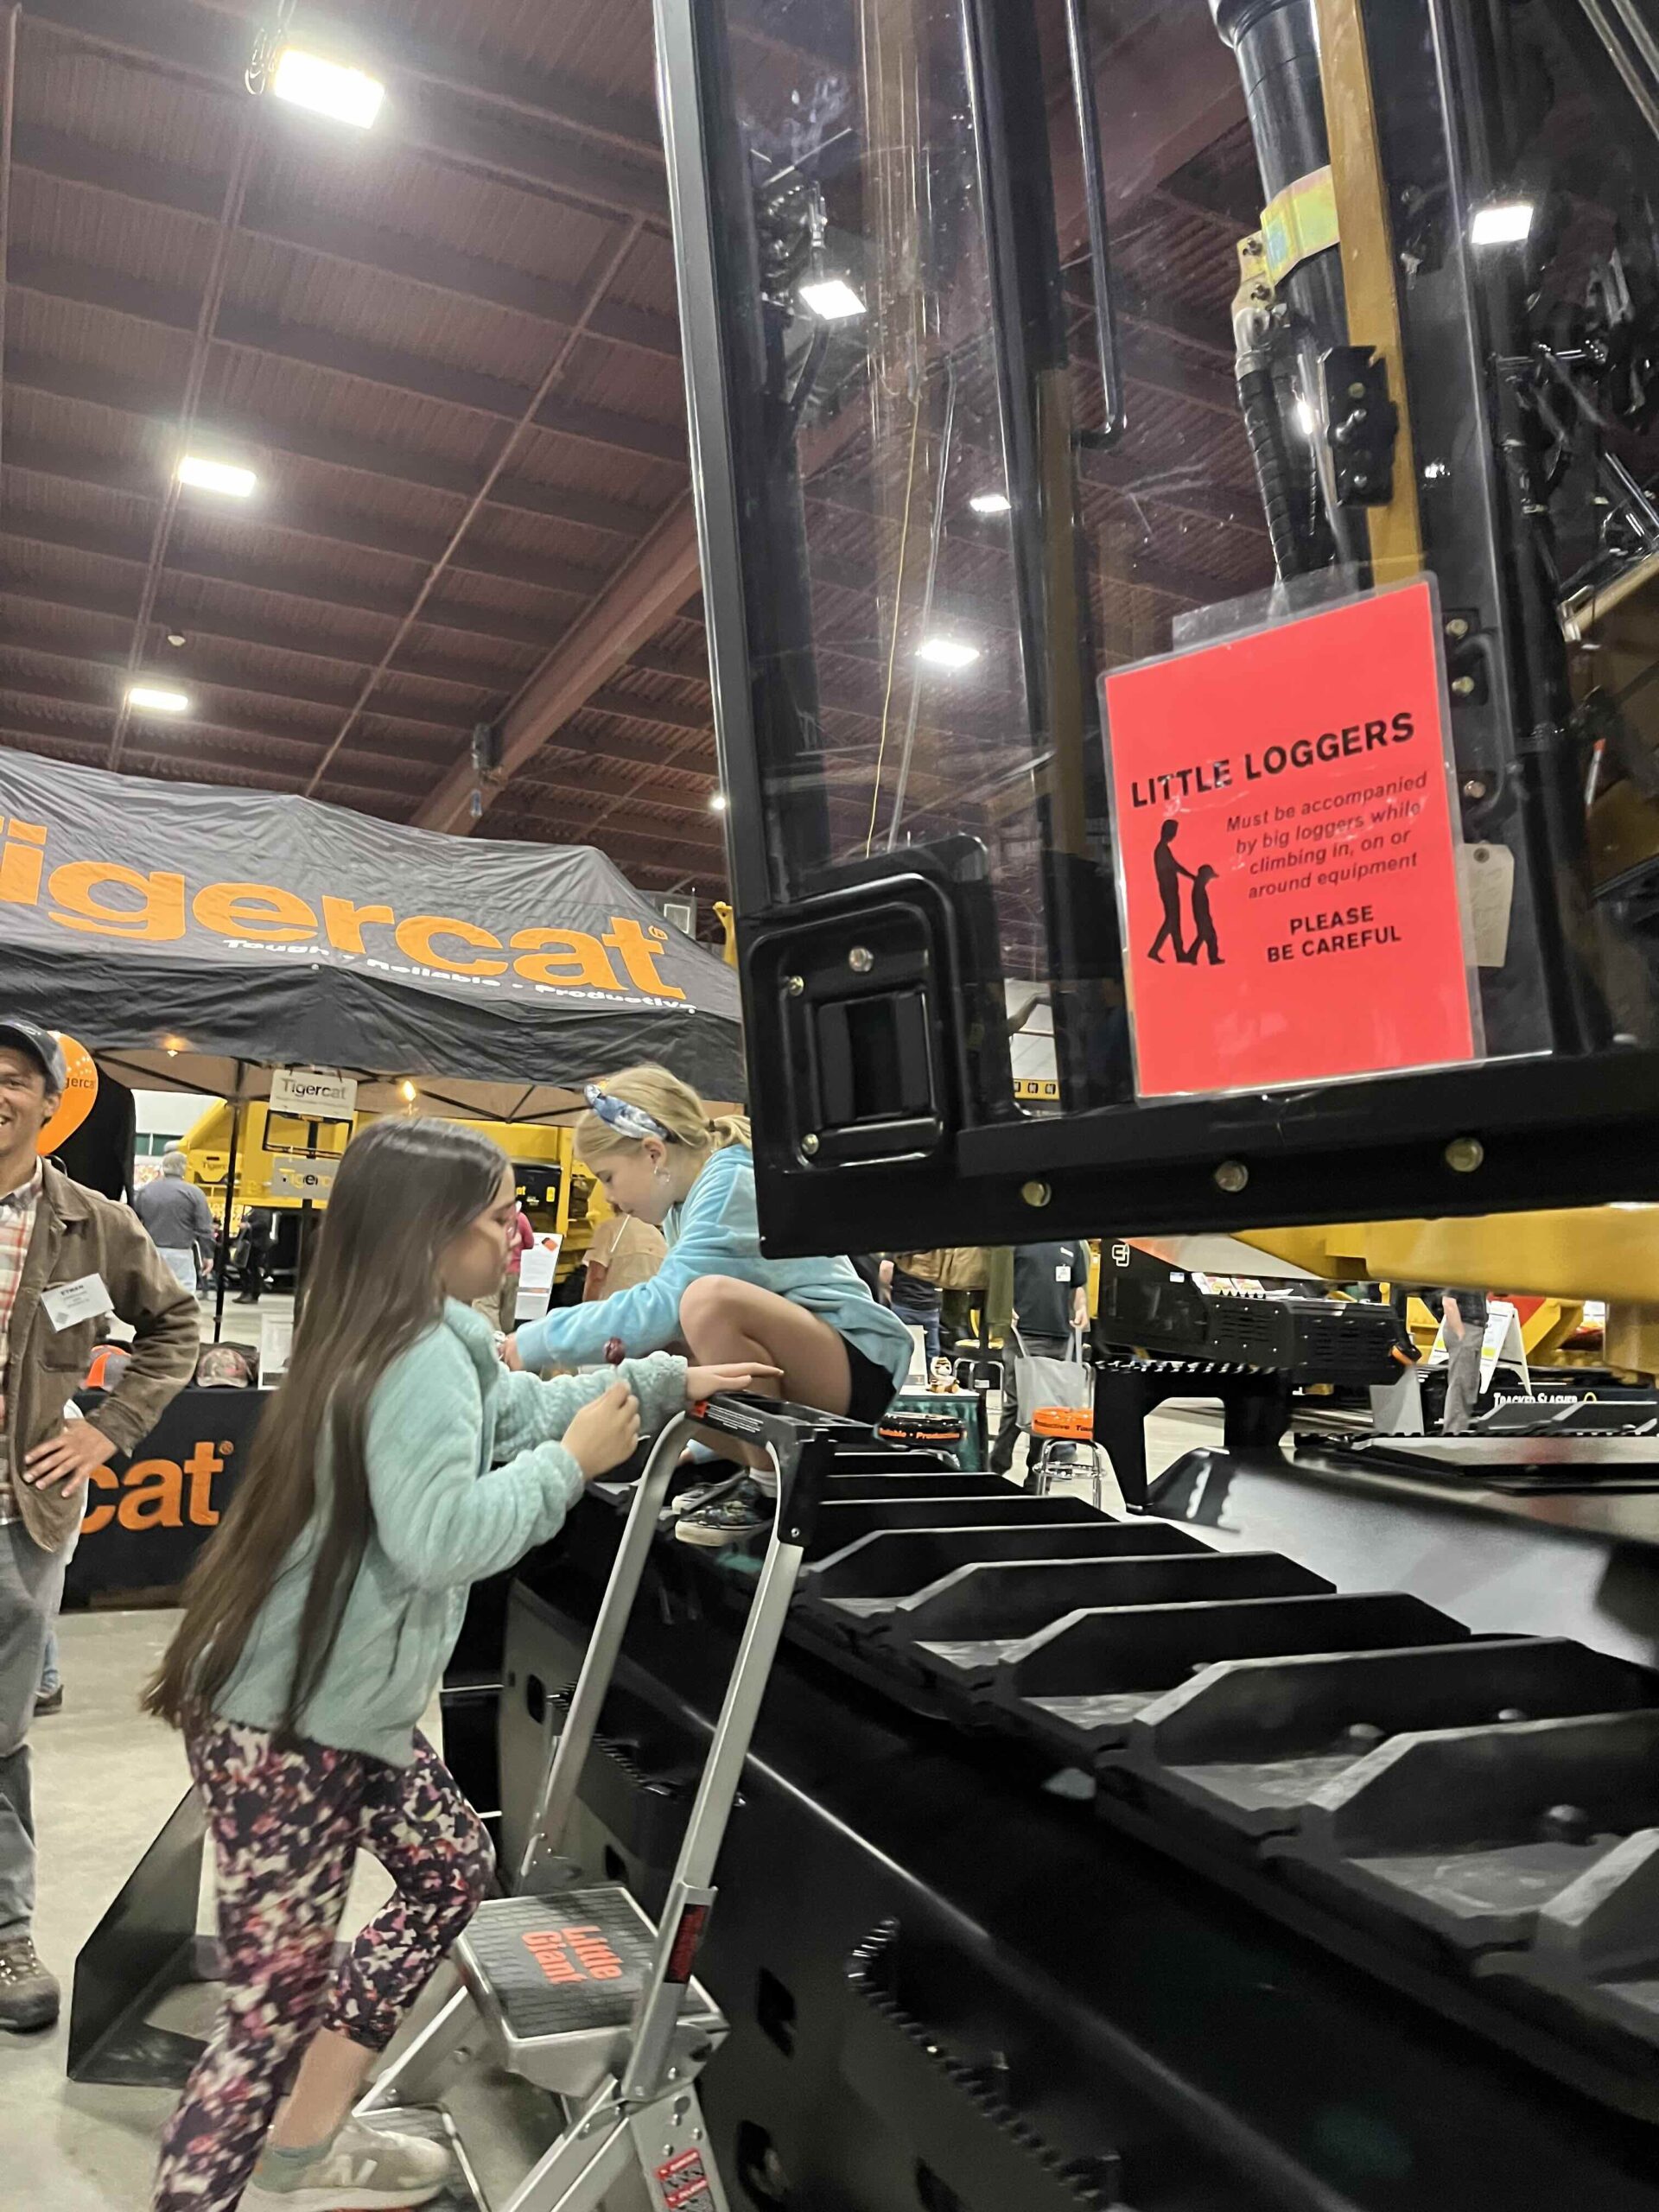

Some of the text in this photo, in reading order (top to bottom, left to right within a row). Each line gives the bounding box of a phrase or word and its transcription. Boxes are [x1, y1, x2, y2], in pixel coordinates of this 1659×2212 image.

[1132, 712, 1414, 807] LITTLE LOGGERS
[1227, 770, 1427, 832] Must be accompanied
[1236, 798, 1422, 855] by big loggers while
[1249, 830, 1411, 874] climbing in, on or
[1249, 852, 1418, 899] around equipment
[0, 815, 687, 1001] igercat
[1290, 905, 1374, 935] PLEASE
[223, 939, 329, 956] Tough
[1268, 925, 1402, 963] BE CAREFUL
[280, 1077, 346, 1100] Tigercat
[521, 1930, 588, 1985] Giant
[560, 1924, 624, 1980] Little
